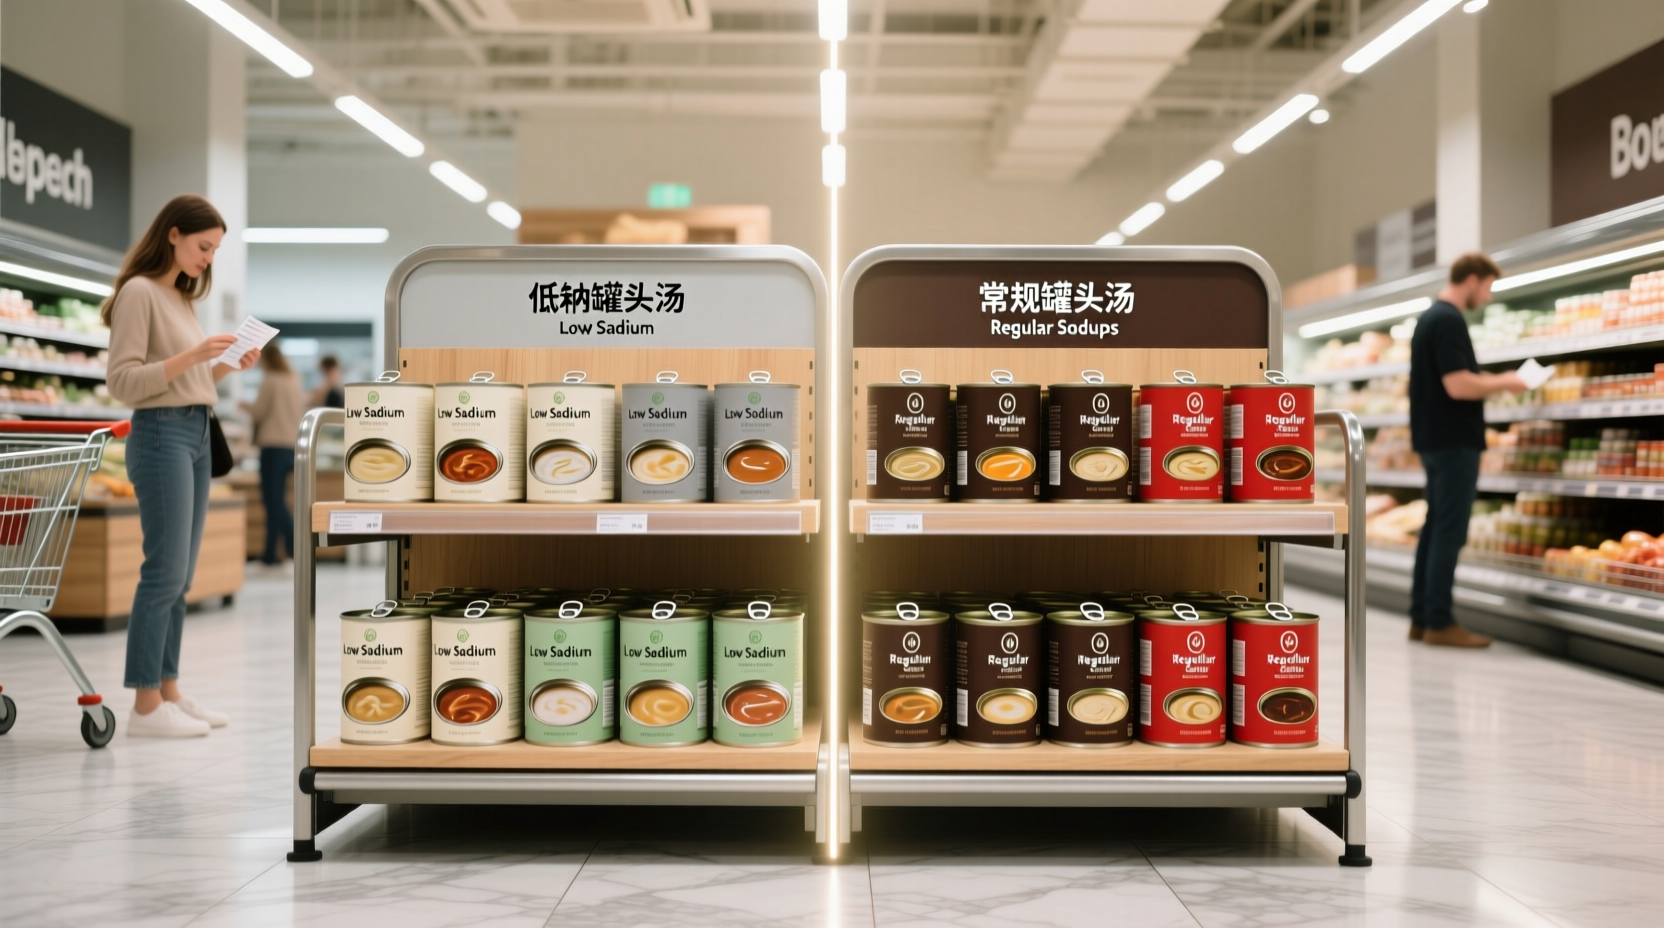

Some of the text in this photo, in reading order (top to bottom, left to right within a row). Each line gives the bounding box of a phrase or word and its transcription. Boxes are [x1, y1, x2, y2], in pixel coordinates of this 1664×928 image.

[979, 280, 1135, 314] 常规罐头汤
[559, 319, 654, 335] Low Sadium
[990, 319, 1119, 339] Regular Sodups
